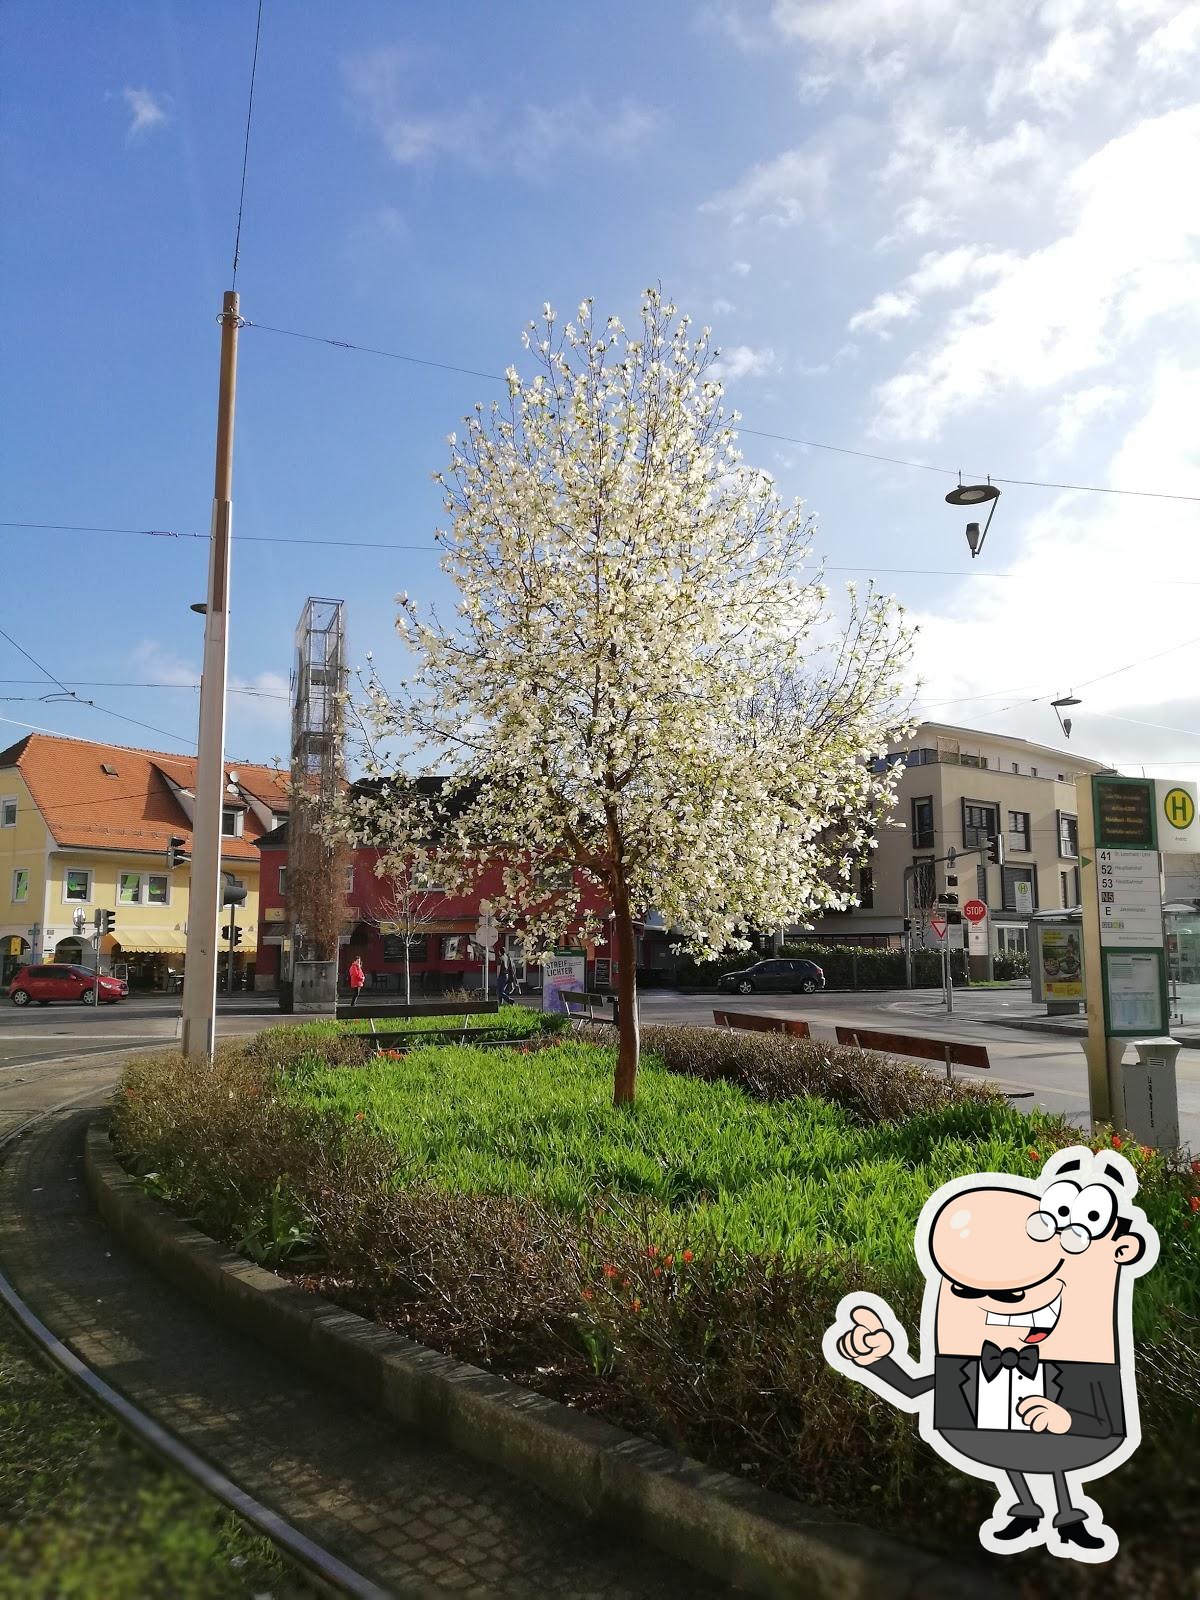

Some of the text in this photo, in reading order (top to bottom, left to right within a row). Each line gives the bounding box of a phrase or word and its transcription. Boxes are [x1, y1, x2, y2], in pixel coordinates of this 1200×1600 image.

[1172, 796, 1187, 821] H
[1100, 851, 1111, 861] 41
[1101, 865, 1112, 874] 52
[1102, 879, 1113, 888] 53
[966, 906, 983, 915] STOP
[1105, 907, 1111, 915] E
[546, 960, 567, 969] STREIF
[547, 967, 573, 976] LICHTER
